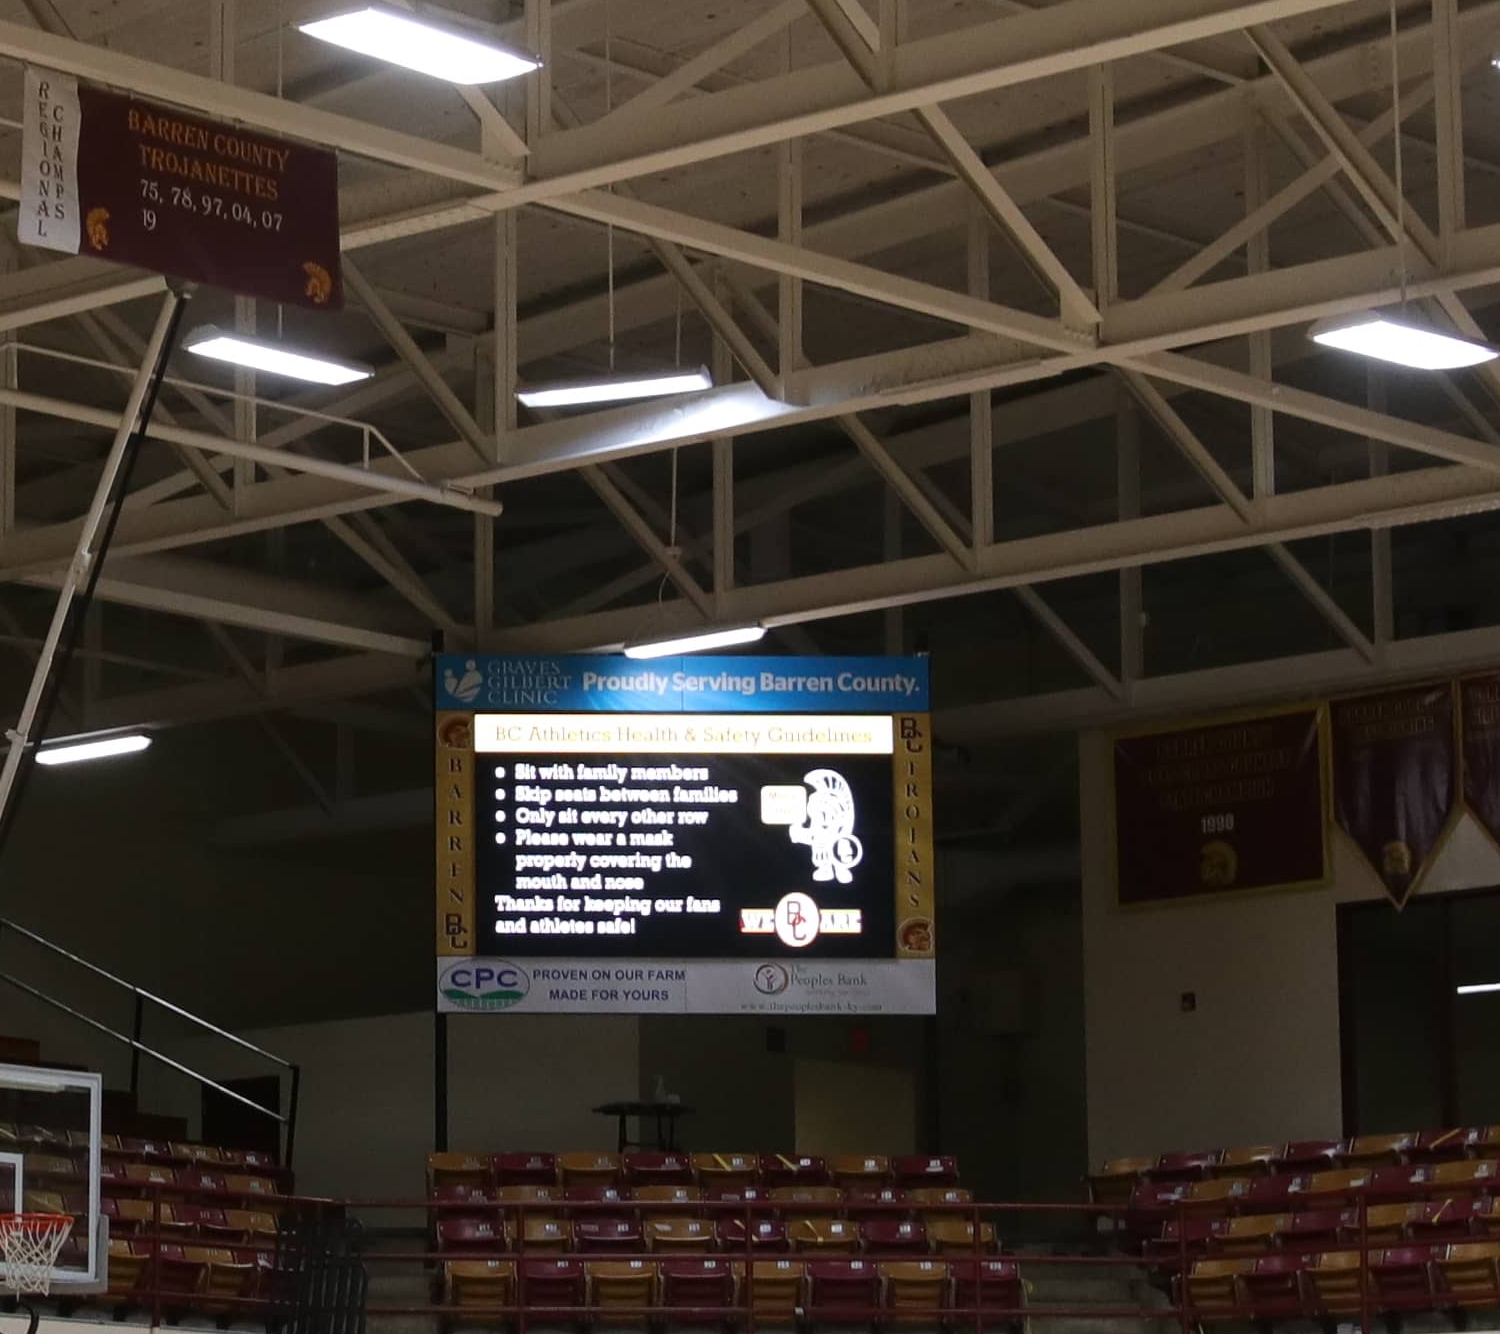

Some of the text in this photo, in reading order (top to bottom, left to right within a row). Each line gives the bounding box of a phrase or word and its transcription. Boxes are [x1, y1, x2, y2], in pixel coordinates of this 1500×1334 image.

[128, 109, 289, 172] BARREN COUNTY
[38, 81, 50, 237] REGIONAL
[53, 104, 65, 220] CHAMPS
[139, 145, 280, 200] TROJANETTES
[140, 178, 164, 204] 75,
[201, 195, 228, 220] 97,
[232, 203, 258, 228] 04,
[262, 210, 283, 232] 07
[143, 208, 158, 232] 19
[488, 659, 562, 676] GRAVES
[488, 675, 571, 691] GILBERT
[583, 672, 920, 697] Proudly Serving Barren County.
[488, 690, 559, 706] CLINIC
[496, 727, 873, 747] BC Athletics Health & Safety Guidelines
[515, 763, 709, 784] Sit with family members
[515, 785, 738, 806] Skip seats between families
[515, 807, 709, 828] Only sit every other row
[515, 829, 674, 846] Please wear a mask
[515, 851, 692, 873] properly covering the
[515, 873, 645, 890] mouth and nose
[494, 895, 721, 916] Thanks for keeping our fans
[495, 917, 636, 935] and athletes safe!
[450, 968, 519, 989] CPC
[533, 969, 687, 983] PROVEN ON OUR FARM
[790, 972, 868, 988] Peoples Bank
[549, 989, 670, 1002] MADE FOR YOURS
